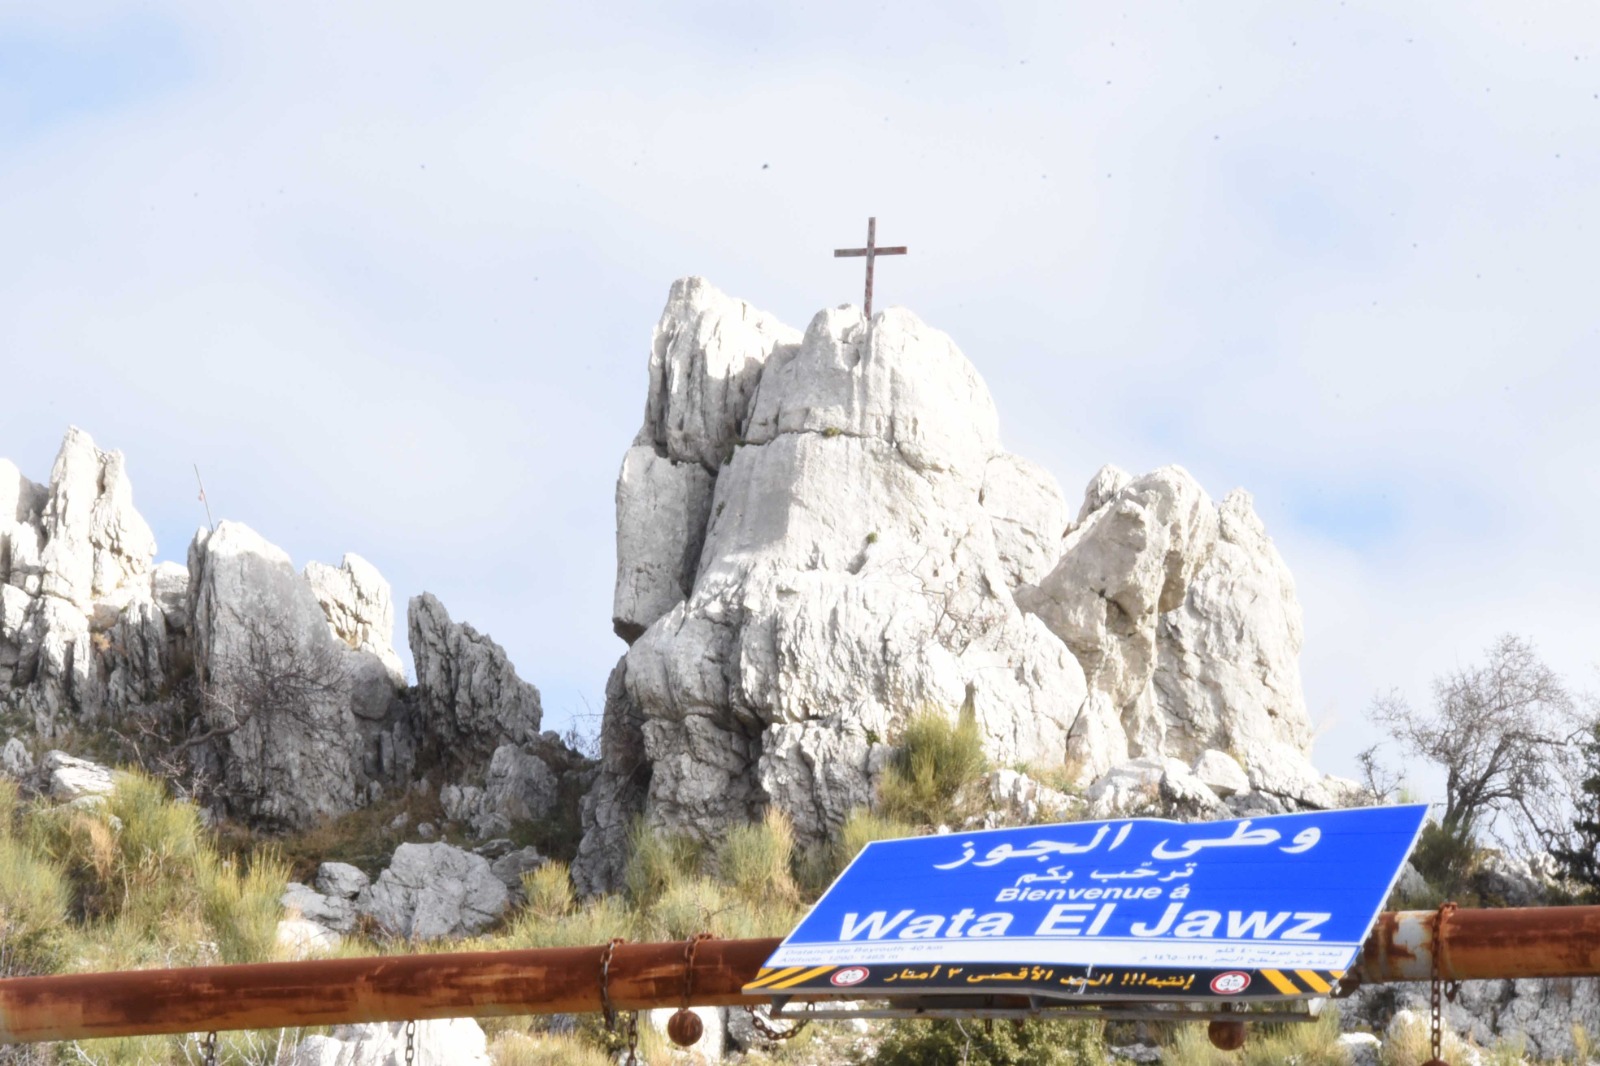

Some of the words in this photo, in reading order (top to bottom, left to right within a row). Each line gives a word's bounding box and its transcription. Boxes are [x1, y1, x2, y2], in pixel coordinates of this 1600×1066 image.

[933, 822, 1134, 870] الجوز
[1015, 865, 1074, 887] بكم
[995, 884, 1162, 903] Bienvenue
[839, 908, 1013, 941] Wata
[1035, 902, 1117, 937] El
[1130, 902, 1332, 941] Jawz
